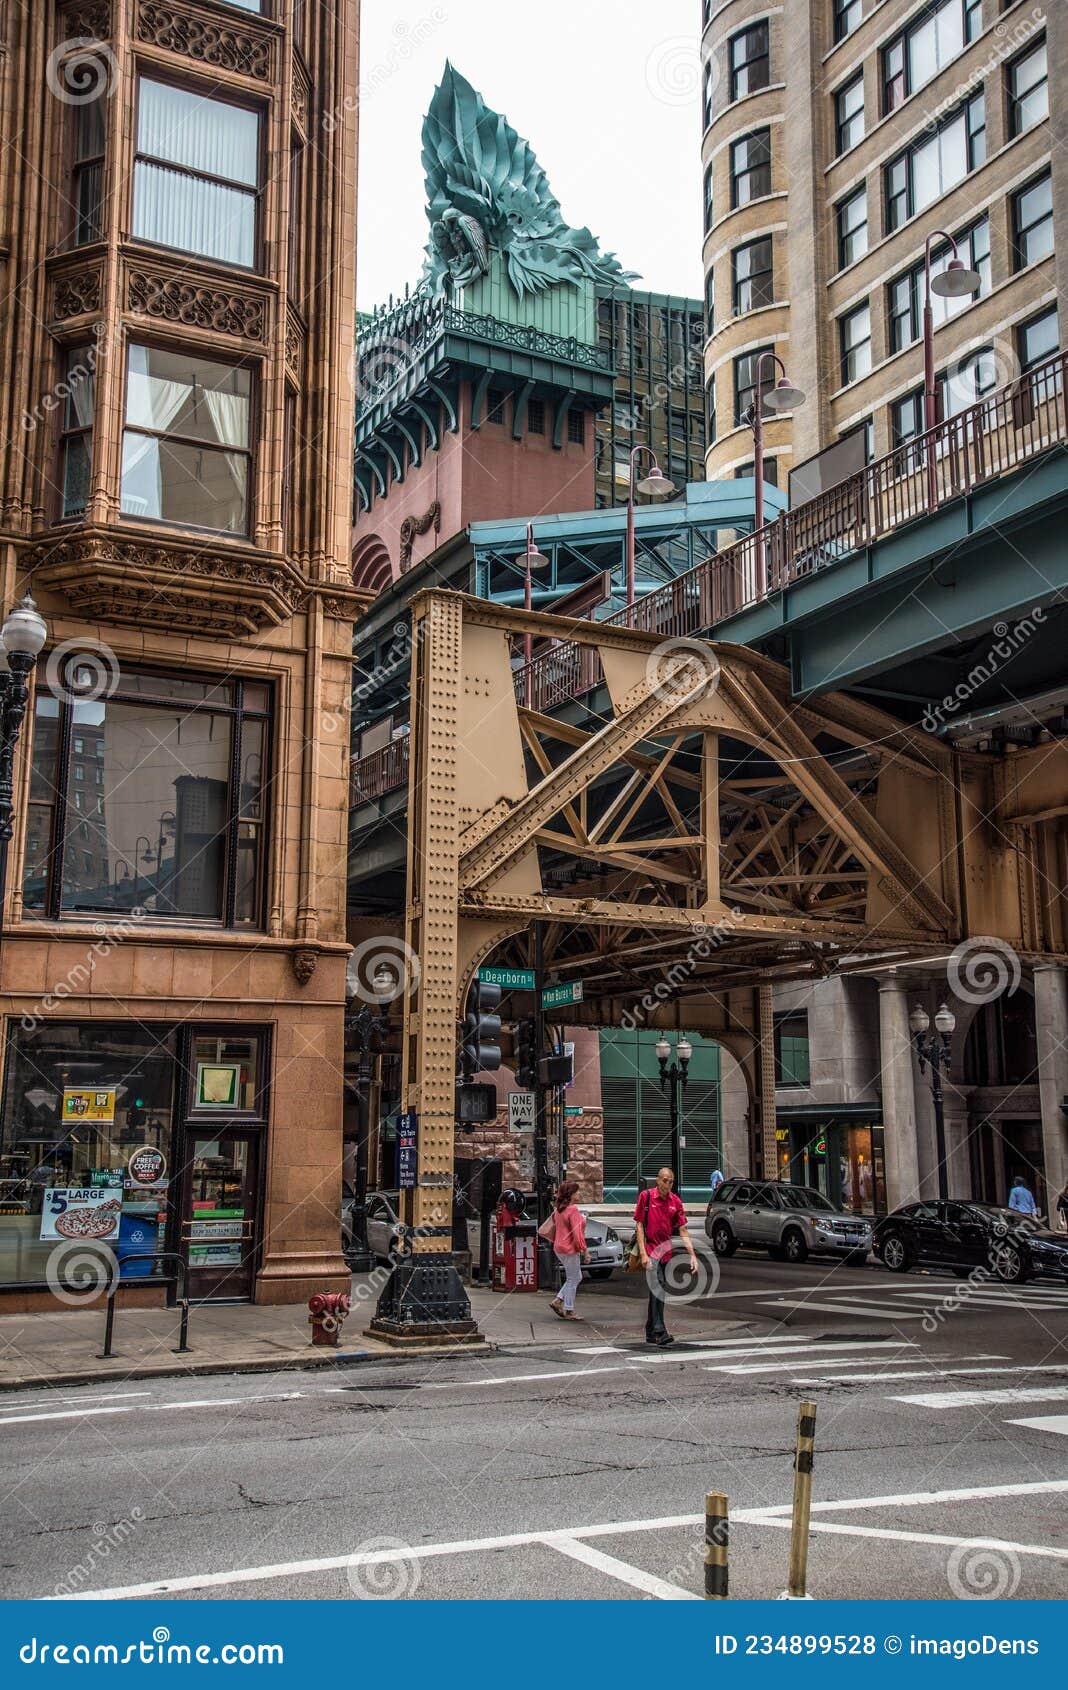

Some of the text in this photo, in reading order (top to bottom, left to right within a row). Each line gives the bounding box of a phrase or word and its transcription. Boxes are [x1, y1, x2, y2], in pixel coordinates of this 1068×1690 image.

[485, 970, 527, 984] Dearborn
[512, 1095, 532, 1105] ONE
[511, 1106, 532, 1116] WAY
[46, 1190, 105, 1214] $5 LARGE
[515, 1274, 535, 1285] EYE
